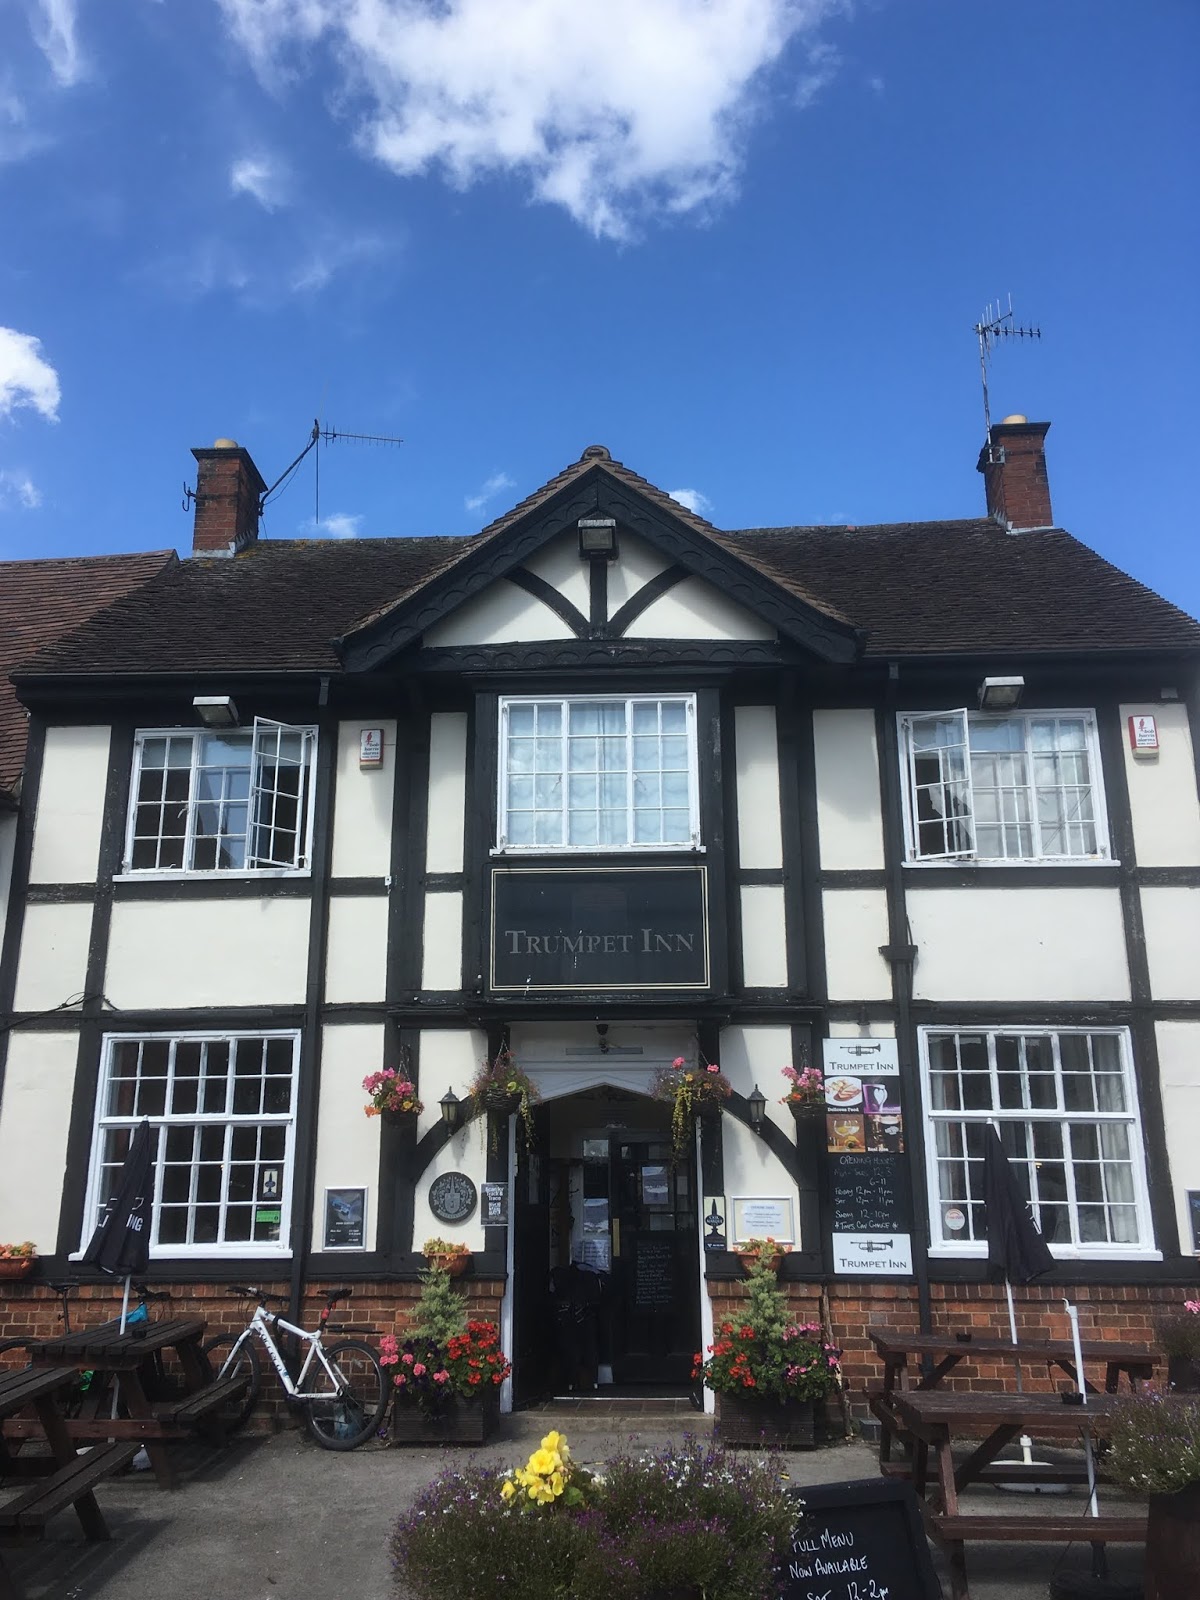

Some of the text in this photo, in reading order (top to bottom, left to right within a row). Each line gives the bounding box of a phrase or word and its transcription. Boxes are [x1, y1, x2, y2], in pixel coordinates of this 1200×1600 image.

[504, 928, 695, 954] TRUMPET INN
[829, 1061, 894, 1071] TRUMPET INN
[839, 1258, 907, 1269] TRUMPET INN
[820, 1528, 854, 1549] MENU
[789, 1555, 868, 1579] NOW AVAILABLE
